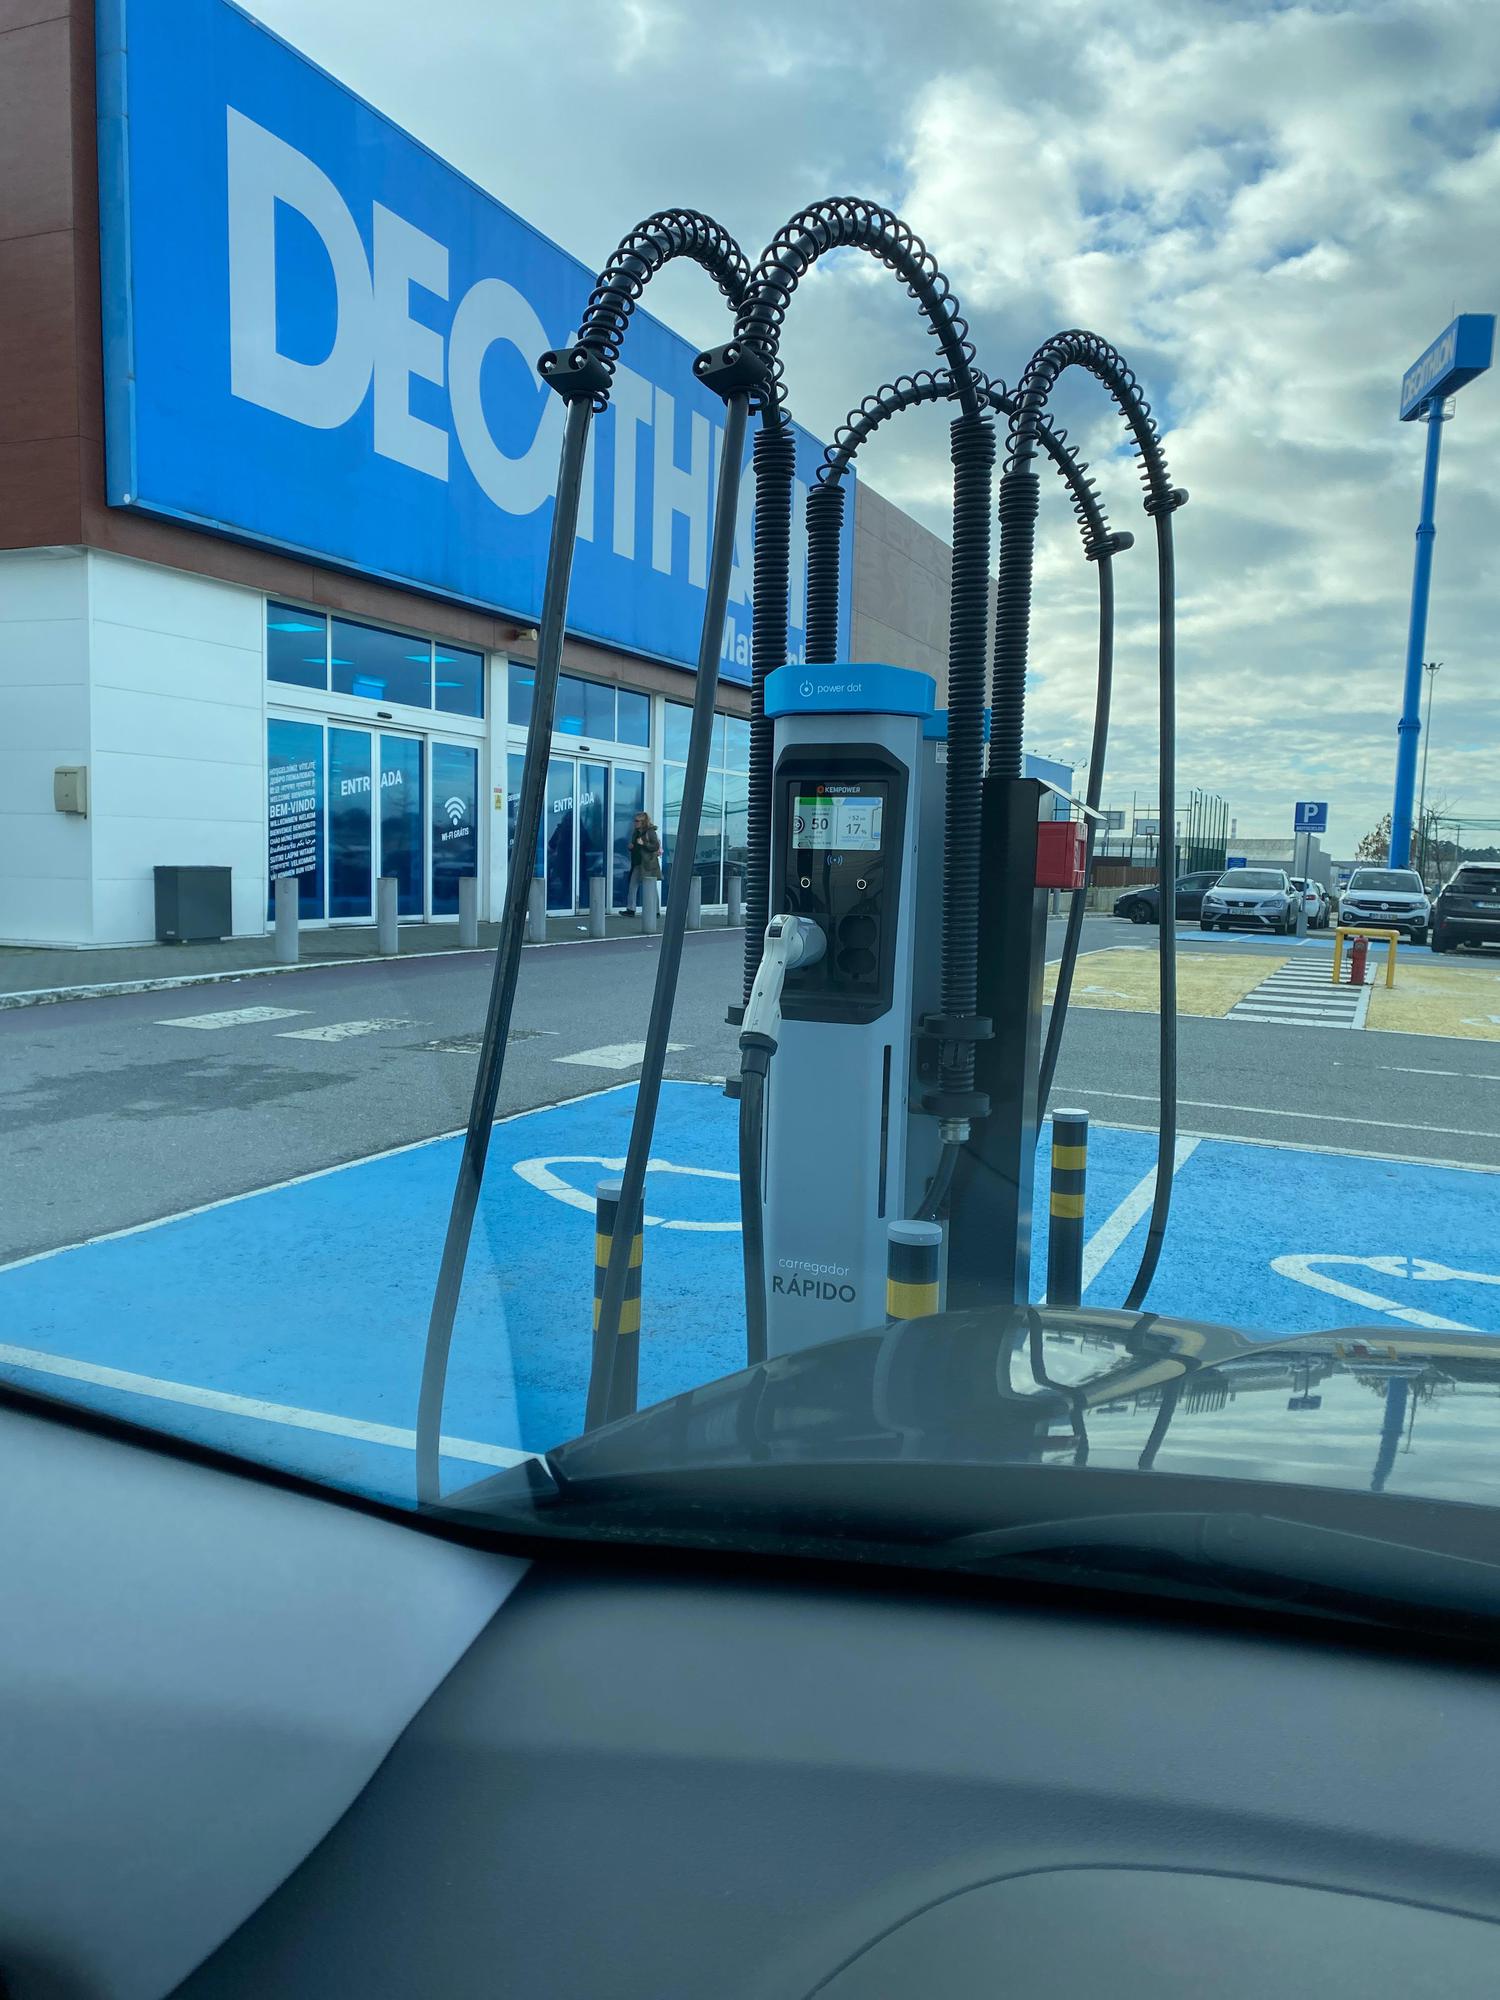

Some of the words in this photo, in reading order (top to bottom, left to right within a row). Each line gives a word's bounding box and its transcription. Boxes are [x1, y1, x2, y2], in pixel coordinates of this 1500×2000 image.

[226, 103, 808, 630] DECTH
[817, 684, 845, 694] power
[846, 683, 862, 693] dot
[341, 770, 403, 796] ENTRADA
[270, 798, 316, 818] BEM-VINDO
[553, 792, 595, 813] ENTRADA
[1303, 803, 1319, 823] P
[811, 817, 830, 831] 50
[845, 823, 861, 835] 17
[778, 1258, 850, 1276] carregador
[772, 1272, 856, 1303] RÁPIDO
